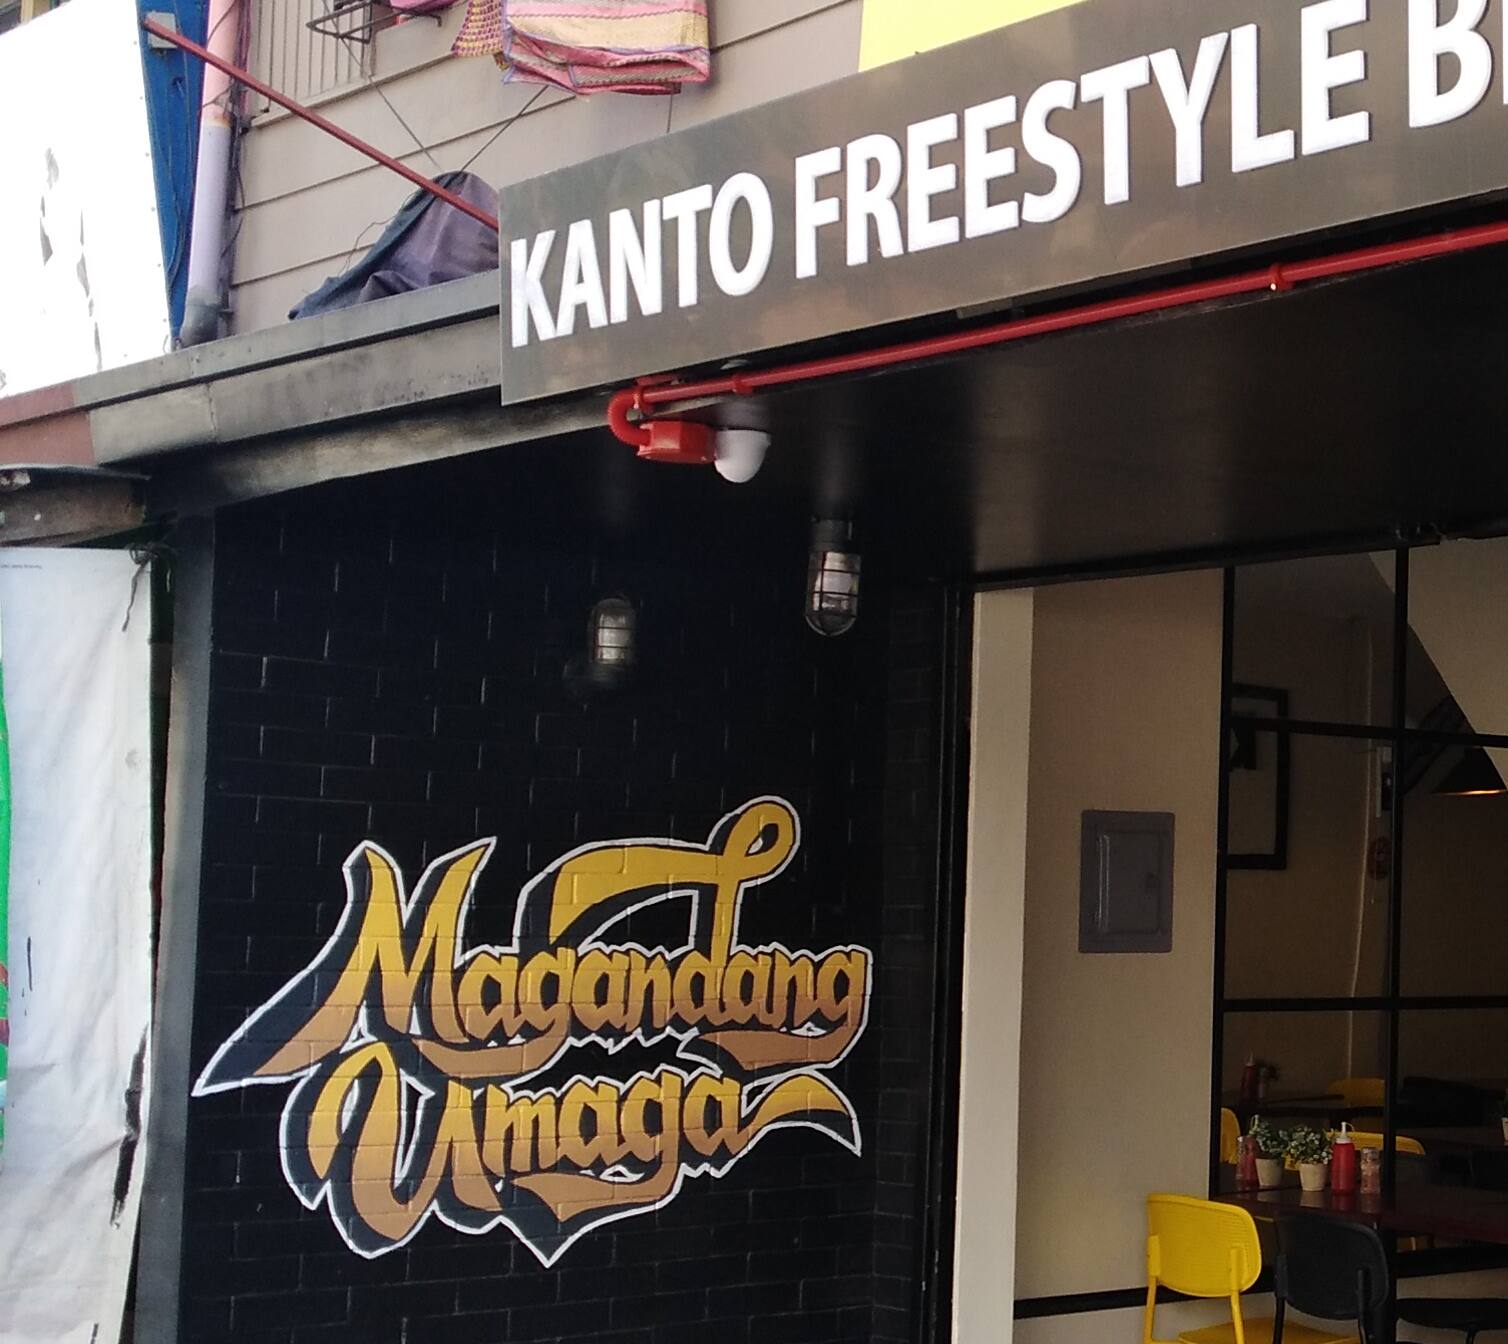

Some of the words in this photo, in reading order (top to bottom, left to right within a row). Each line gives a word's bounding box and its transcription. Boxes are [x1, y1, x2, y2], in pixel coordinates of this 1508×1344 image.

[509, 170, 774, 348] KANTO
[192, 795, 873, 1096] Magandang
[281, 1042, 862, 1262] Umaga
